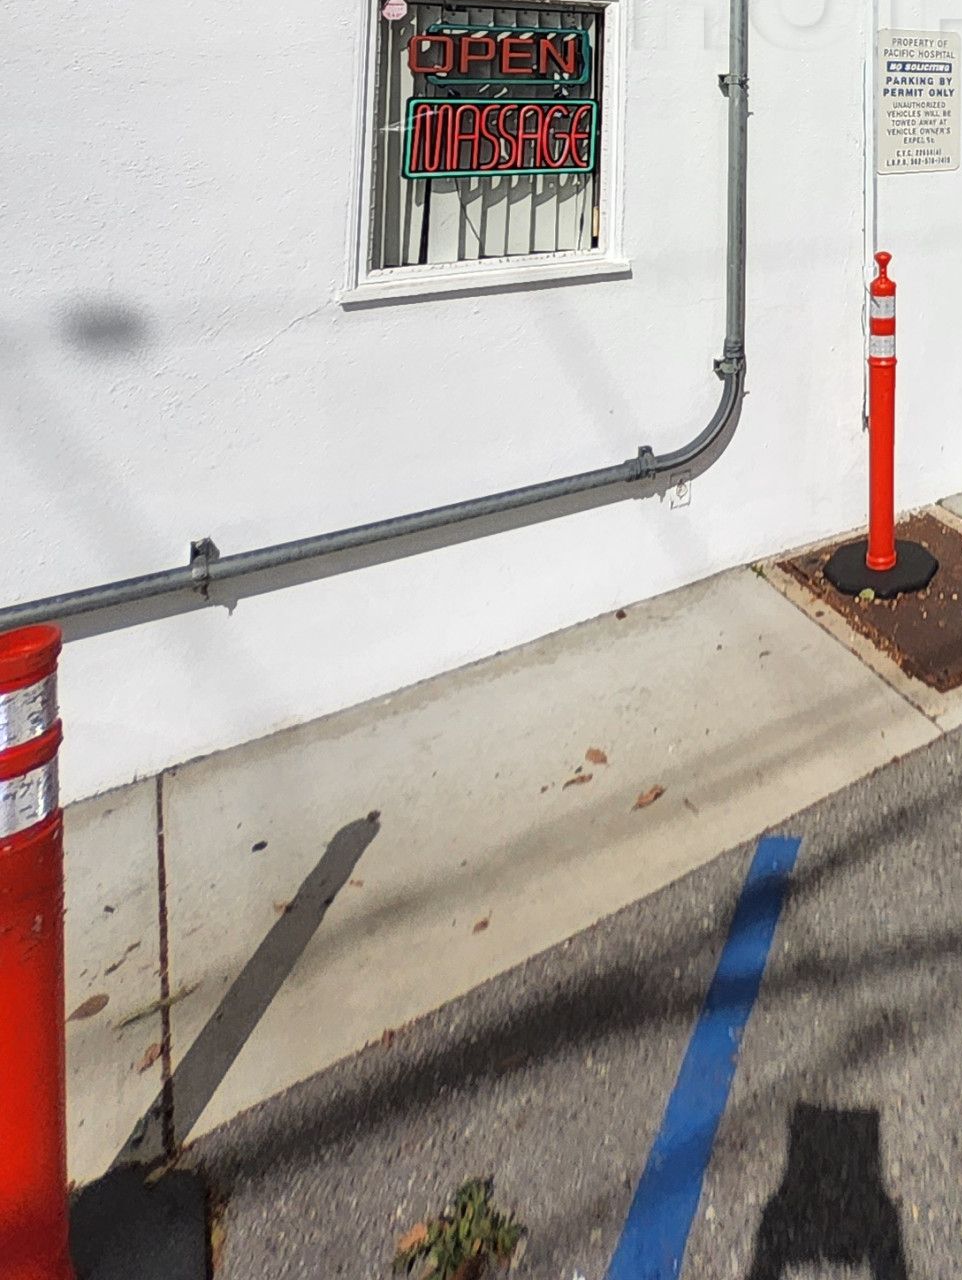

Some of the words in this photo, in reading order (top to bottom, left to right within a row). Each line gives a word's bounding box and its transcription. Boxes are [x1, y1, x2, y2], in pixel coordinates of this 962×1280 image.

[892, 38, 934, 47] PROPERTY
[937, 40, 948, 48] OF
[409, 36, 576, 73] OPEN
[884, 49, 916, 58] PACIFIC
[918, 50, 955, 59] HOSPITAL
[886, 76, 934, 85] PARKING
[939, 77, 952, 86] BY
[883, 88, 924, 97] PERMIT
[929, 89, 955, 97] ONLY
[892, 101, 946, 109] UNAUTHORIZED
[886, 110, 921, 118] VEHICLES
[892, 119, 917, 127] TOWED
[887, 128, 916, 136] VEHICLE
[410, 104, 592, 171] MASSAGE
